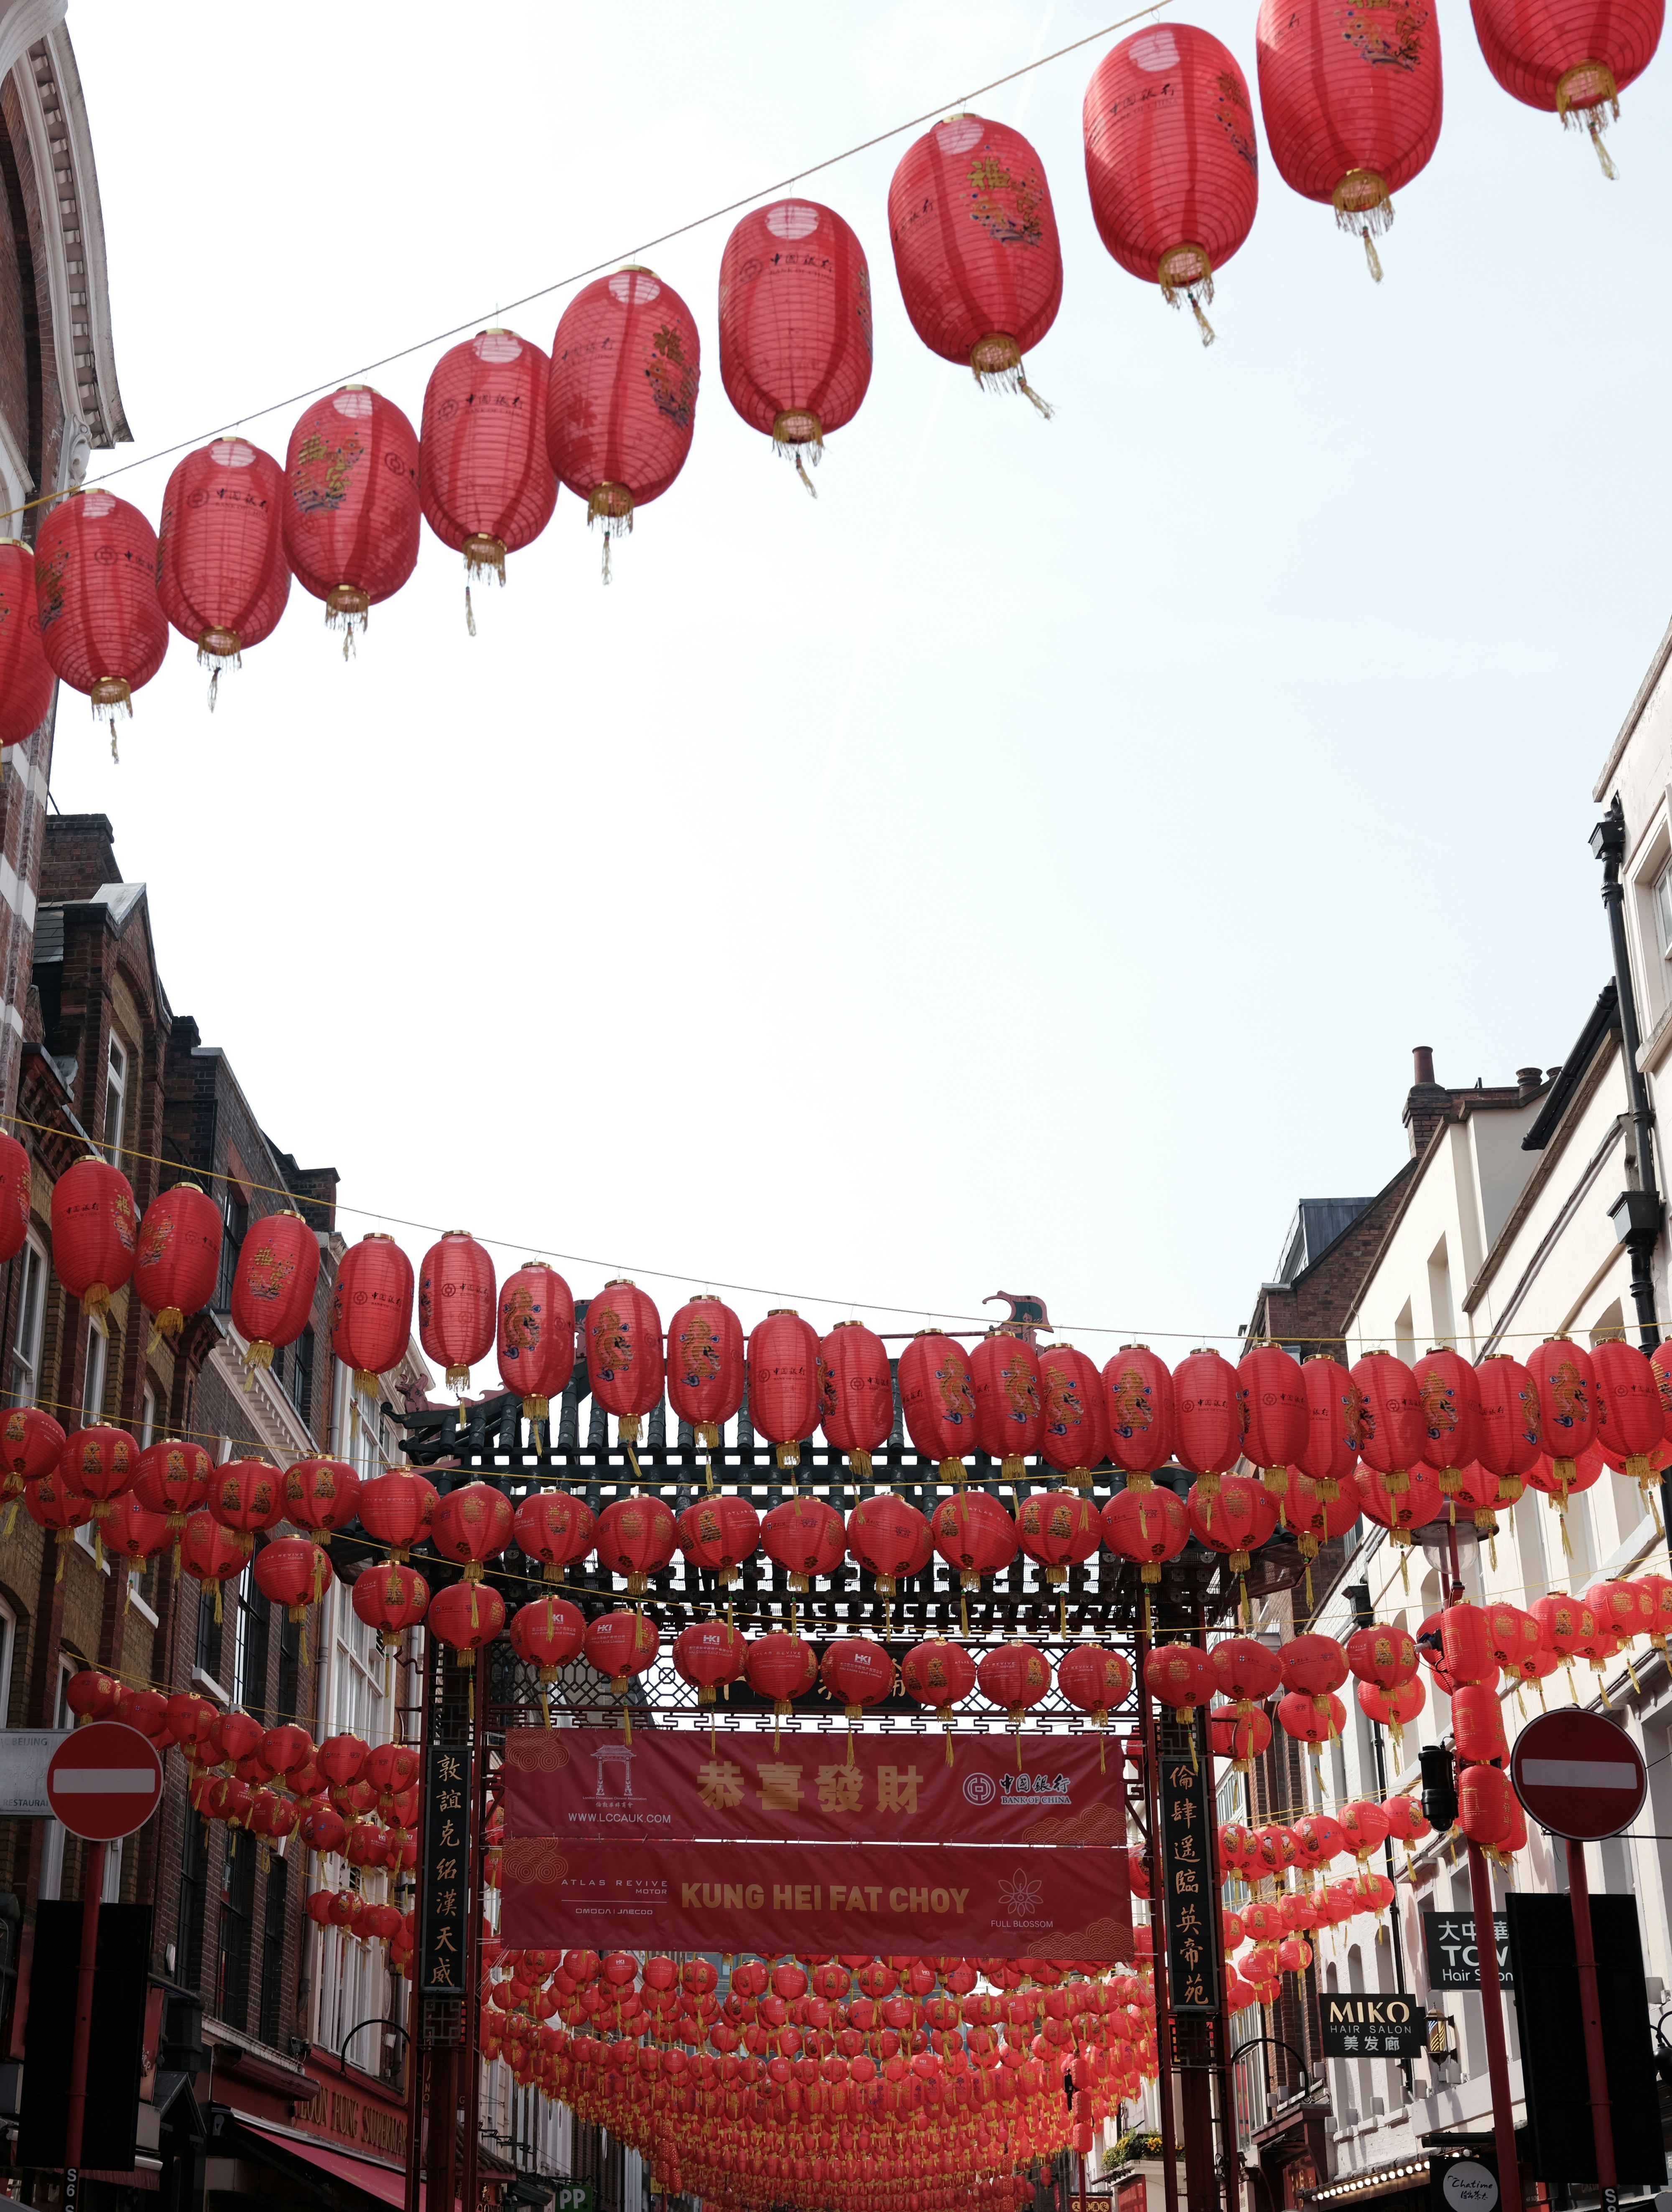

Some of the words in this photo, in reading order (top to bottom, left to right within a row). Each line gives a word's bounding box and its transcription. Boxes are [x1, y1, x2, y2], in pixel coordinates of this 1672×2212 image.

[855, 1654, 871, 1664] HKI
[12, 1738, 48, 1746] BEIJING
[697, 1760, 923, 1814] 恭喜發財
[568, 1812, 671, 1824] WWW.LCCAUK.COM
[682, 1883, 765, 1910] KUNG
[773, 1884, 821, 1911] HEI
[829, 1885, 883, 1912] FAT
[890, 1886, 969, 1914] CHOY
[1013, 1920, 1053, 1928] BLOSSOM
[1443, 1969, 1471, 1981] Hair
[1476, 1969, 1514, 1981] Son
[1330, 2001, 1410, 2024] MIKO
[1330, 2025, 1360, 2034] HAIR
[1369, 2025, 1412, 2034] SALON
[1343, 2035, 1400, 2052] 美发廊
[1452, 2179, 1493, 2189] Chatime
